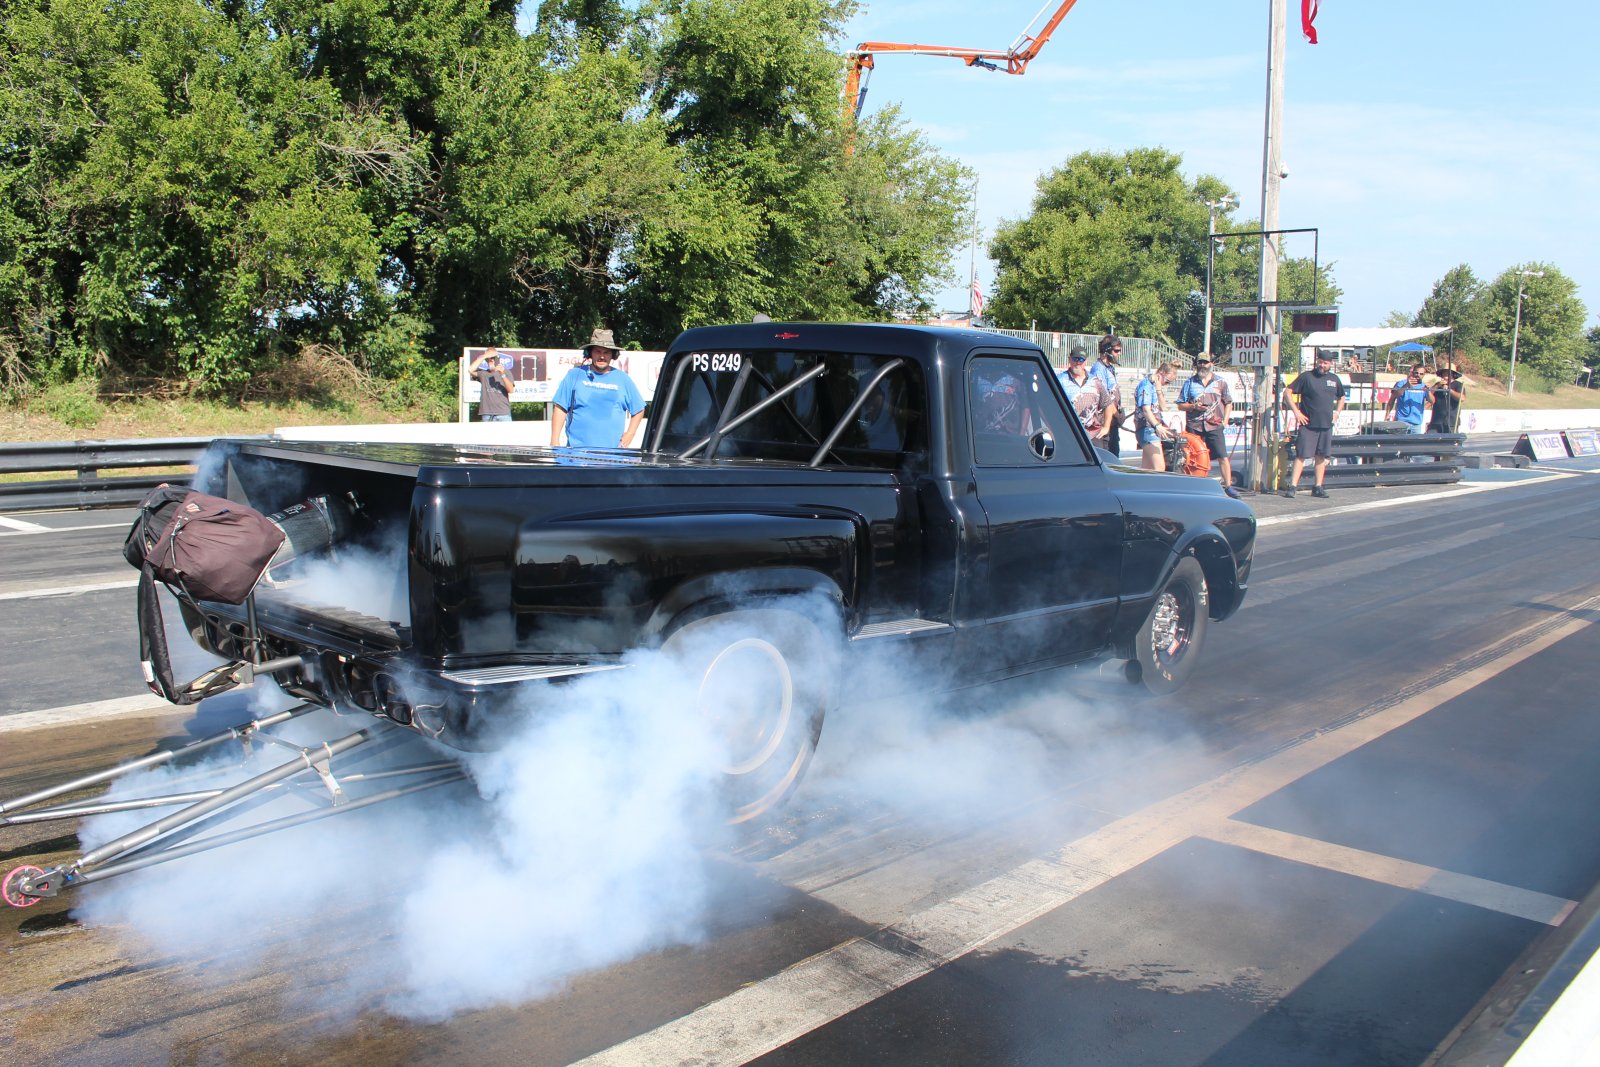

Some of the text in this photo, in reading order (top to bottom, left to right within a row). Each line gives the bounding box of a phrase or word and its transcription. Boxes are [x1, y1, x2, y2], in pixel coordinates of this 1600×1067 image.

[1235, 335, 1268, 349] BURN
[692, 353, 741, 372] PS 6249
[1239, 350, 1264, 364] OUT
